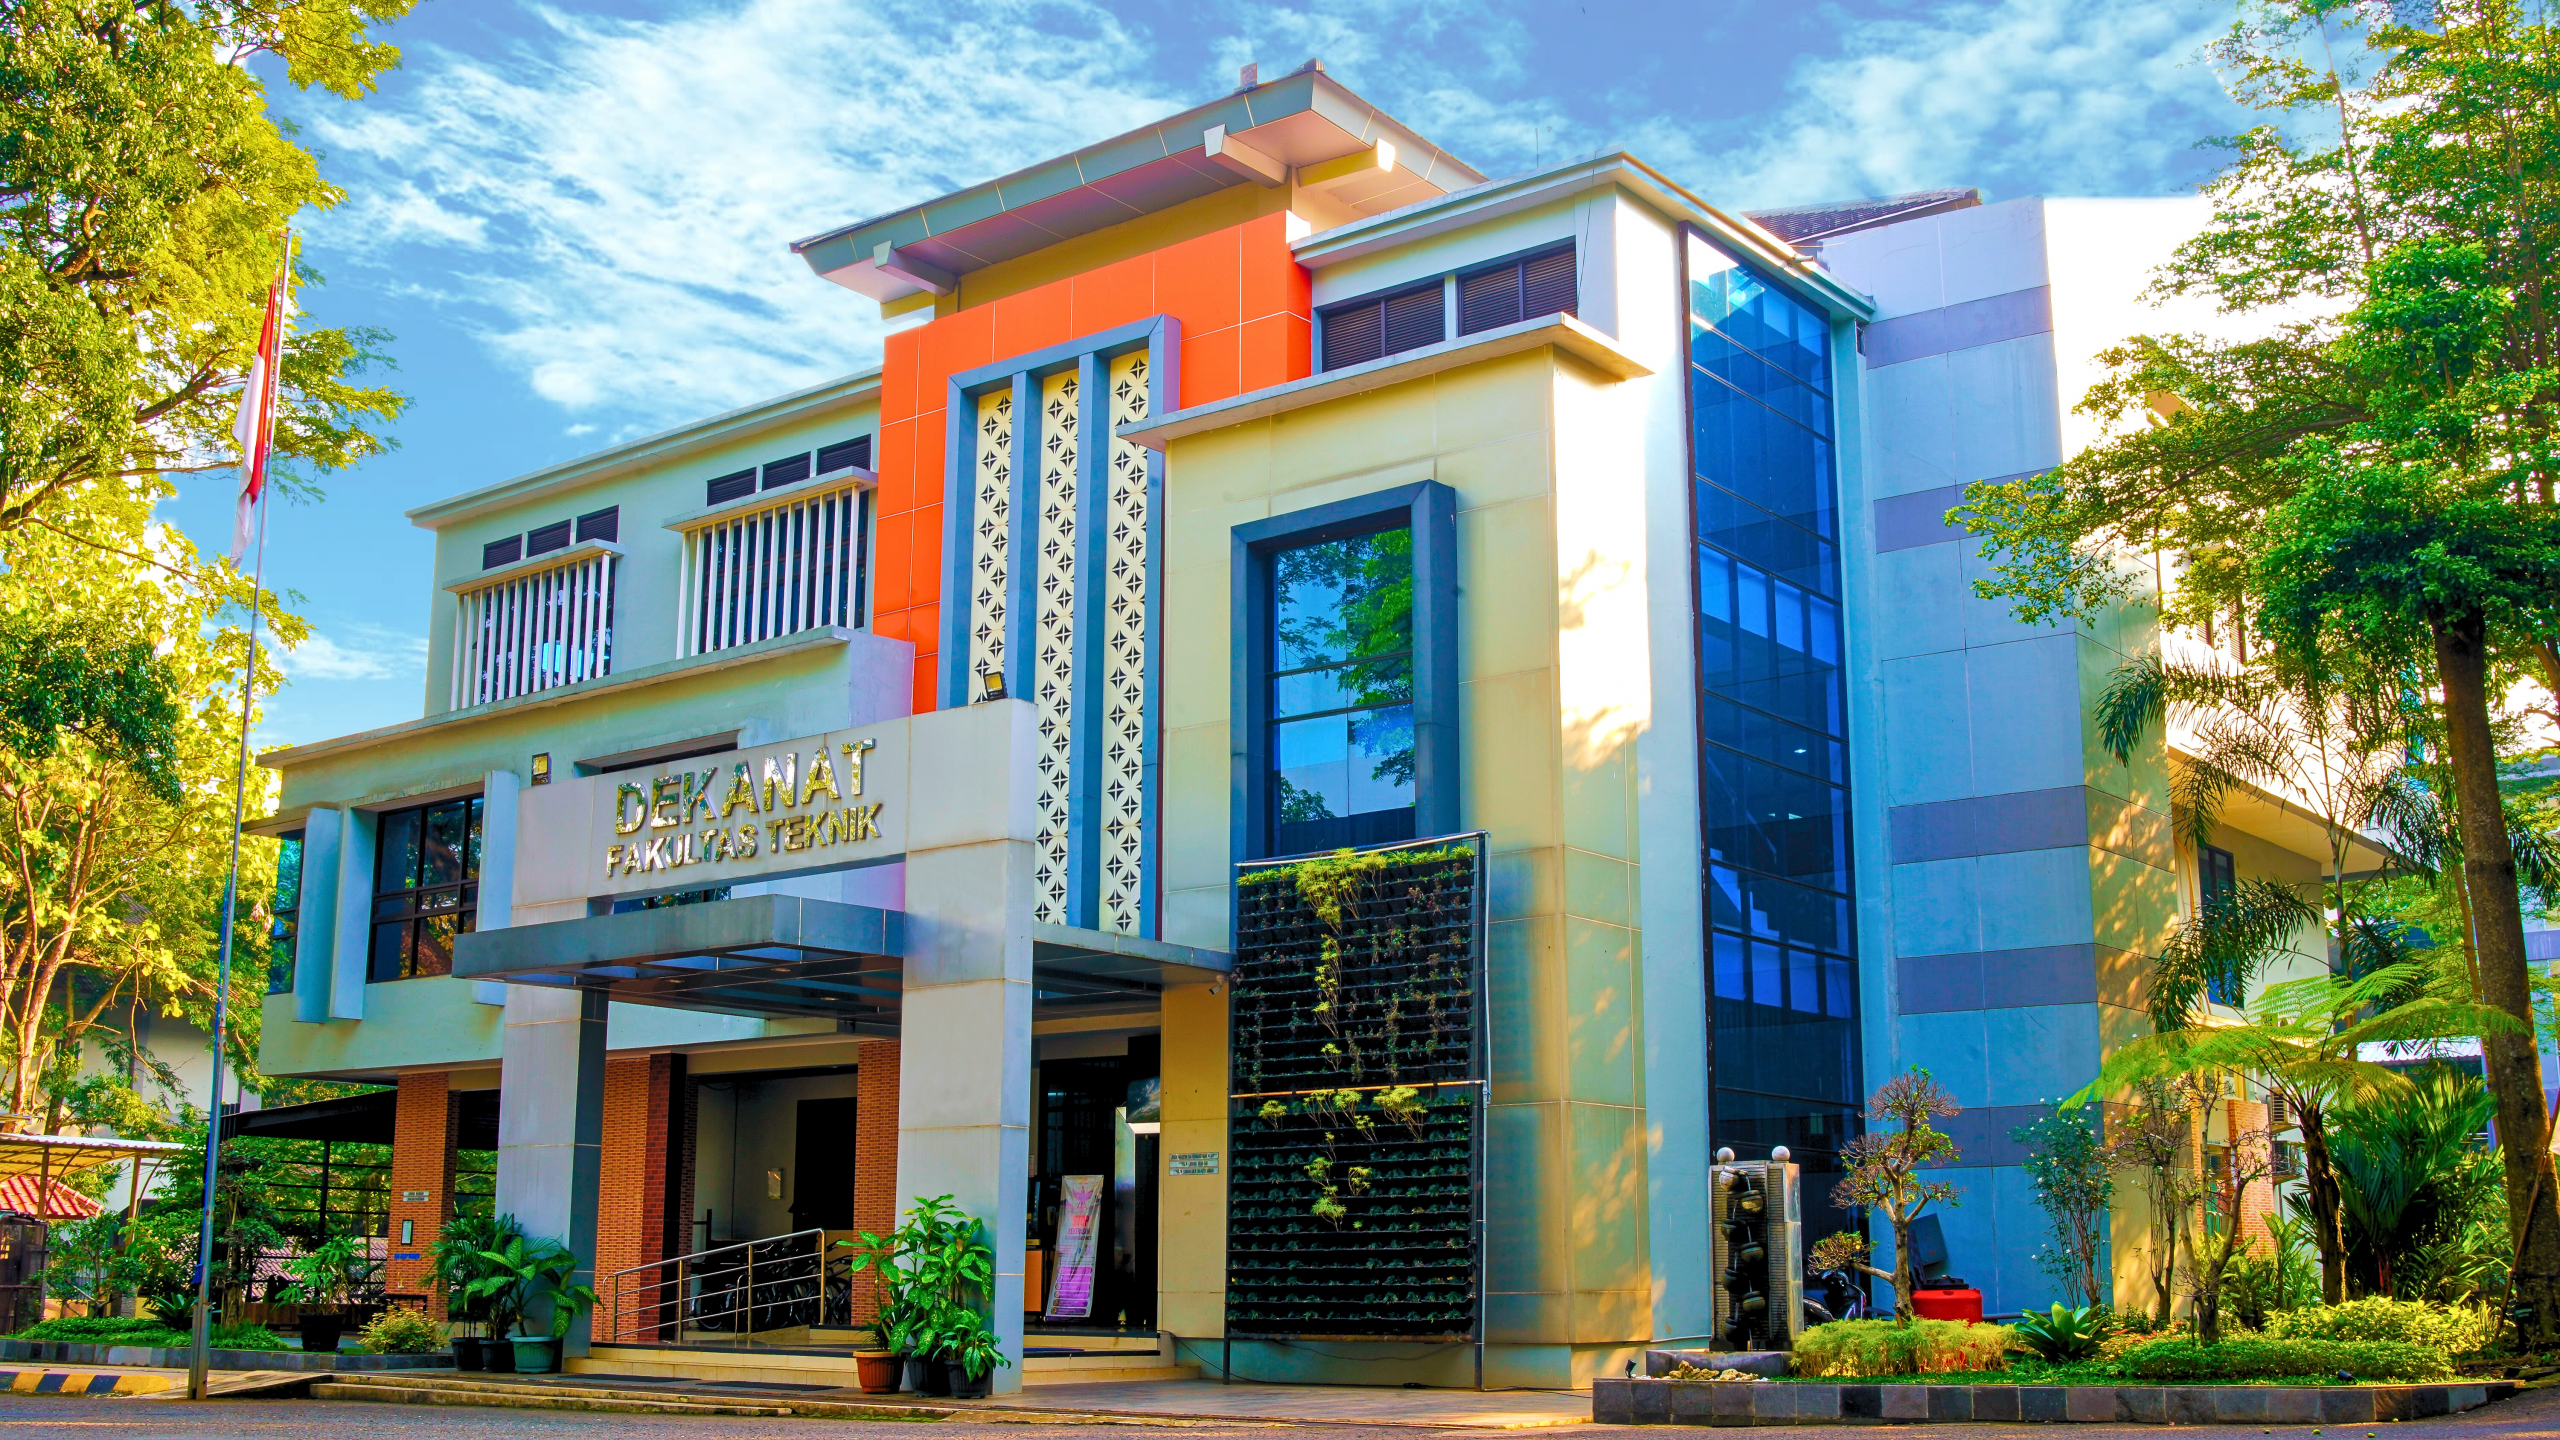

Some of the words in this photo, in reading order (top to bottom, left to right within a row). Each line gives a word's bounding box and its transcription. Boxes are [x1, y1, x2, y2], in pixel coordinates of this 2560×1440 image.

[615, 738, 876, 835] DEKANAT
[606, 824, 758, 877] FAKULTAS
[766, 803, 883, 853] TEKNIK
